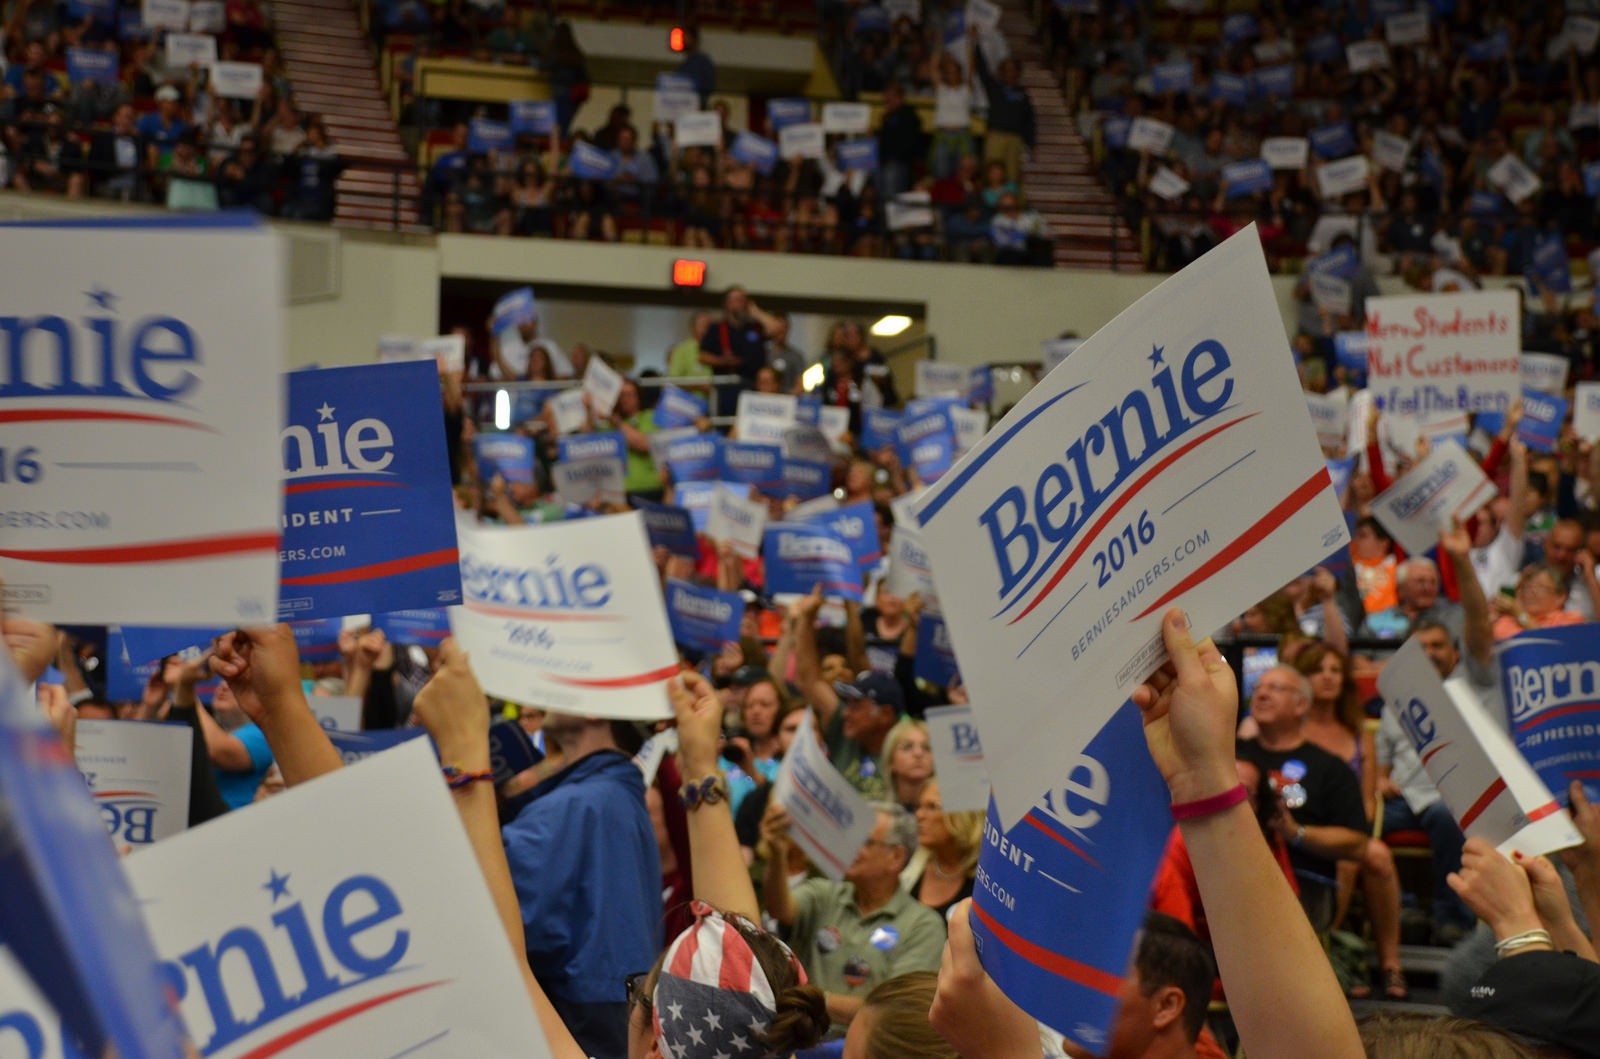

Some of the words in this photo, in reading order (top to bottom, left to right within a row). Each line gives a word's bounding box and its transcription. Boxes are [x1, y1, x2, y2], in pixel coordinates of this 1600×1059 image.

[0, 284, 202, 402] nie
[0, 446, 43, 484] 16
[281, 402, 395, 474] nie
[979, 338, 1234, 600] Bernie
[282, 508, 354, 529] IDENT
[1092, 509, 1156, 589] 2016
[1071, 528, 1211, 662] BERNIESANDERS.COM
[1508, 660, 1600, 718] Bern
